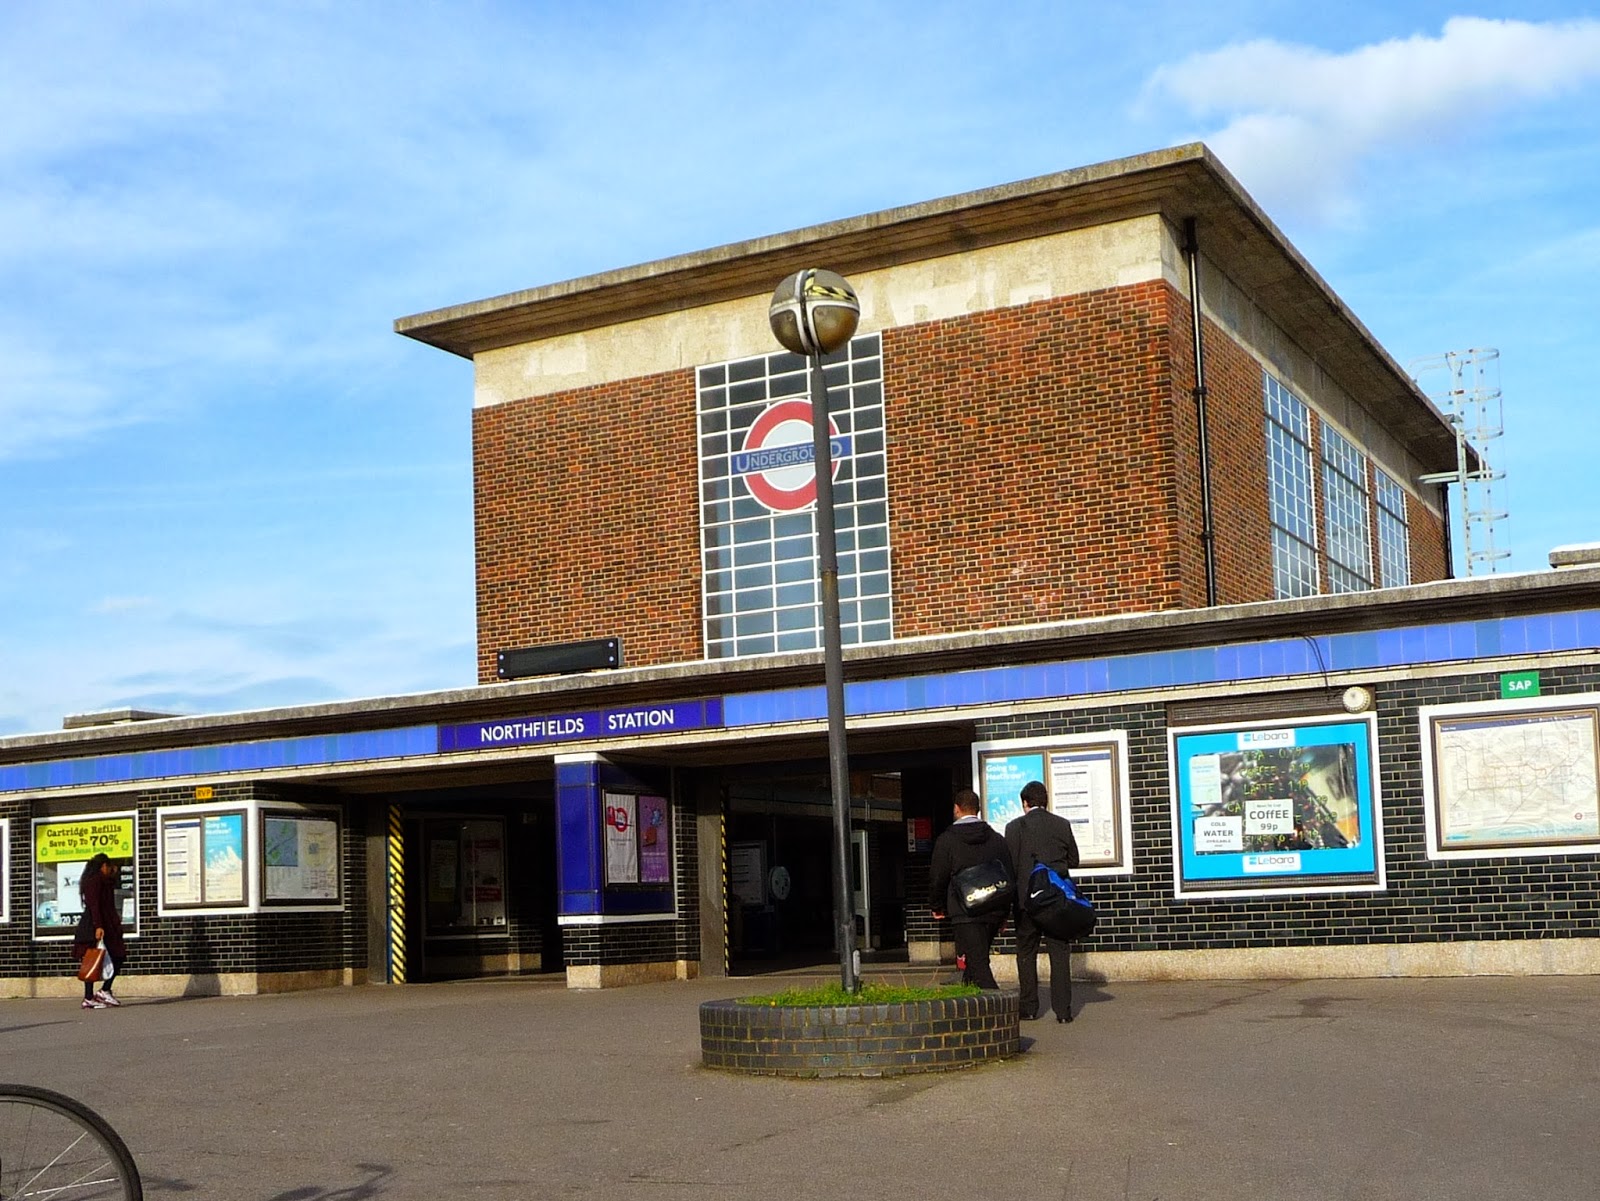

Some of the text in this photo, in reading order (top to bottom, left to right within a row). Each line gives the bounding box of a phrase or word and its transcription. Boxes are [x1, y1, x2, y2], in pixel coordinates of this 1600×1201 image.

[736, 440, 843, 472] UNDERGROUD
[1508, 680, 1532, 691] SAP
[481, 709, 675, 742] NORTHFIELDS STATION
[1252, 732, 1289, 741] Lebara
[47, 825, 122, 838] Cartridge Refills
[1260, 823, 1278, 831] 99p
[68, 839, 78, 847] Up
[90, 834, 119, 846] 70%
[1258, 856, 1295, 865] Lebara
[966, 884, 997, 902] adidas
